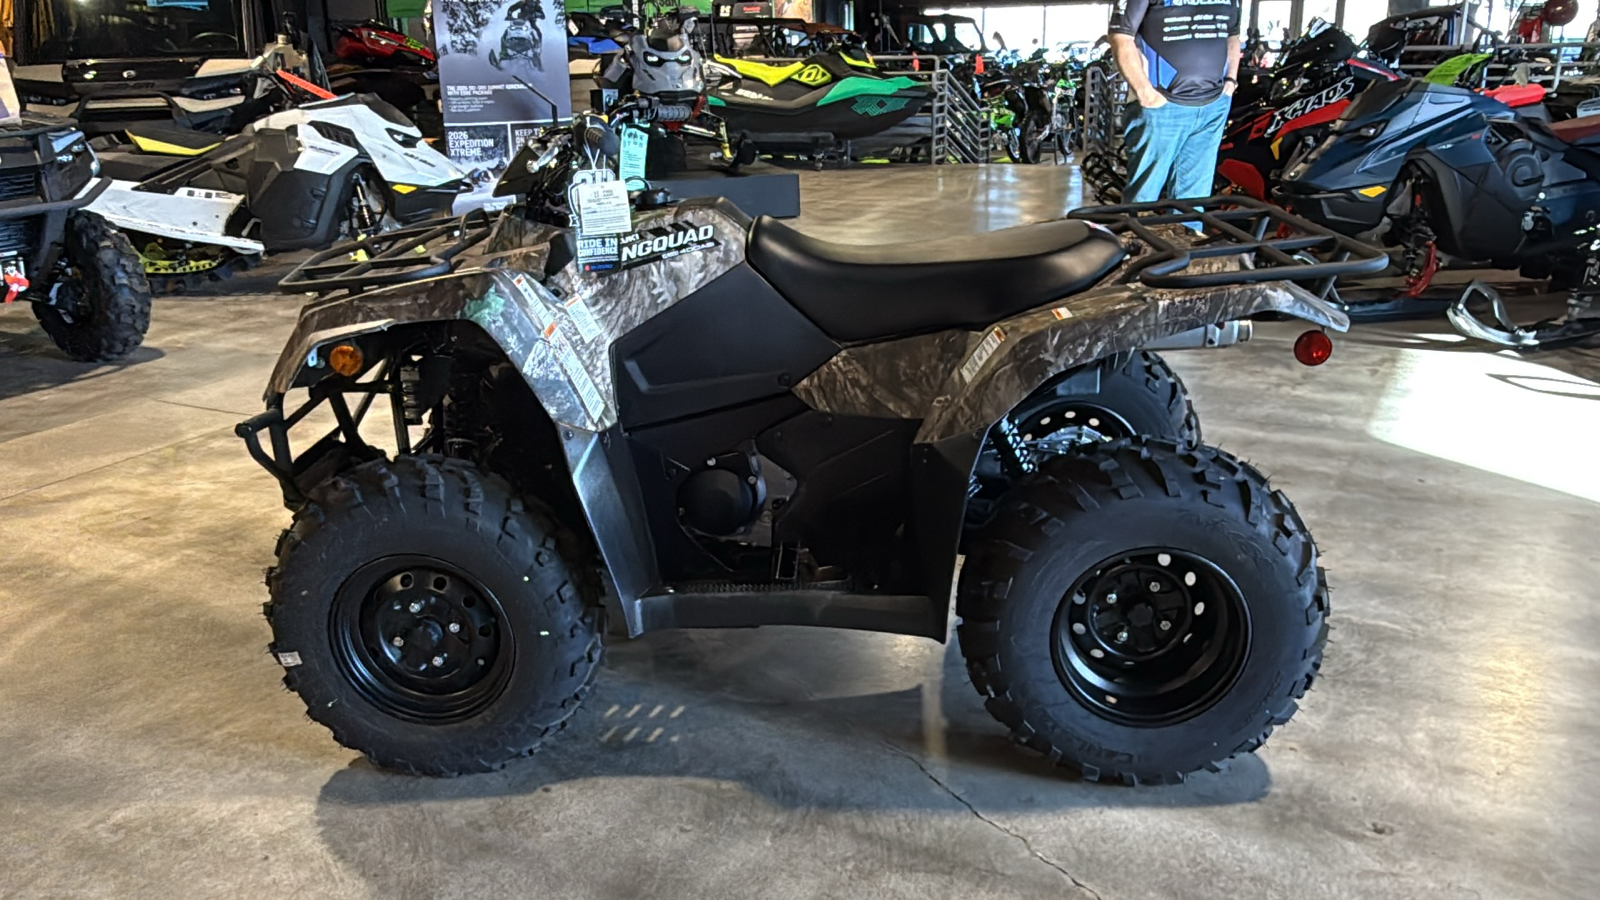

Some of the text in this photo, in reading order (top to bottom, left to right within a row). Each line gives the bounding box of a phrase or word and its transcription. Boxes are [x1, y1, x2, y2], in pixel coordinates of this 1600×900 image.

[448, 131, 468, 139] 2026
[448, 138, 494, 148] EXPEDITION
[450, 147, 482, 157] XTREME
[576, 237, 618, 249] RIDE IN
[621, 225, 714, 262] NGQUAD
[577, 246, 619, 258] CONFIDENCE
